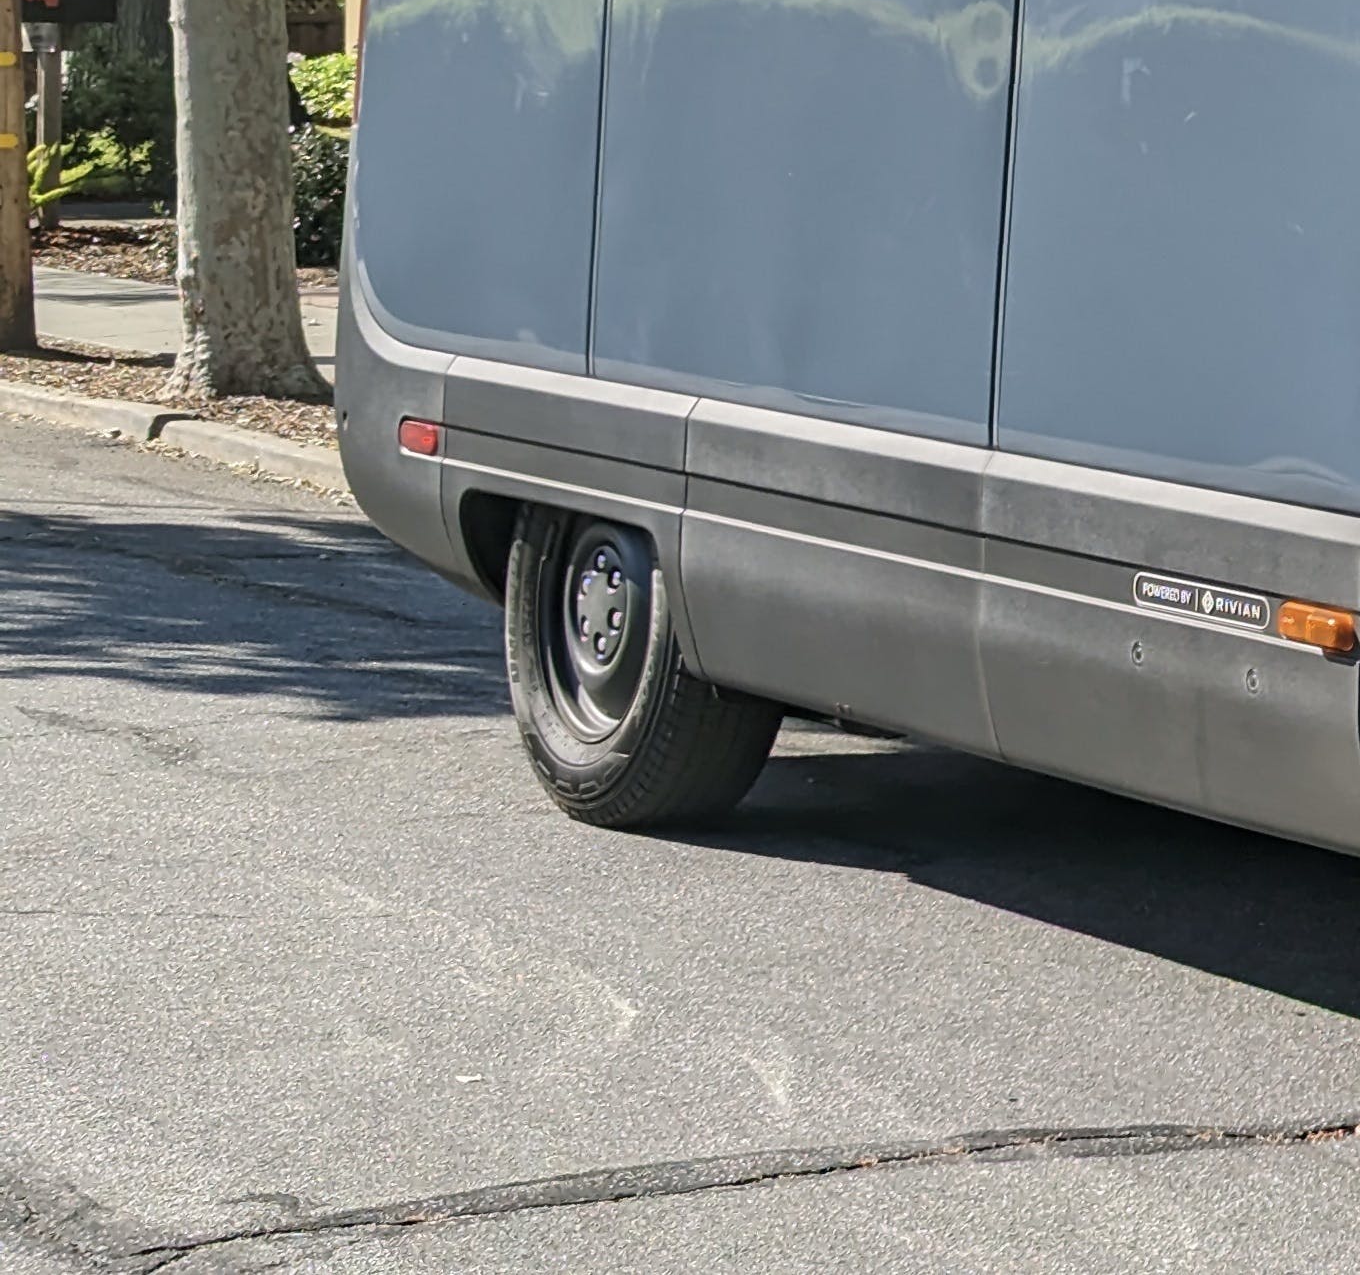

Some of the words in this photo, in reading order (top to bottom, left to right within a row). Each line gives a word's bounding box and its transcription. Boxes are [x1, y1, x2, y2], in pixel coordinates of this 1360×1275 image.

[1142, 582, 1180, 602] POWERED
[1180, 589, 1192, 604] BY
[1215, 597, 1262, 619] RIVIAN
